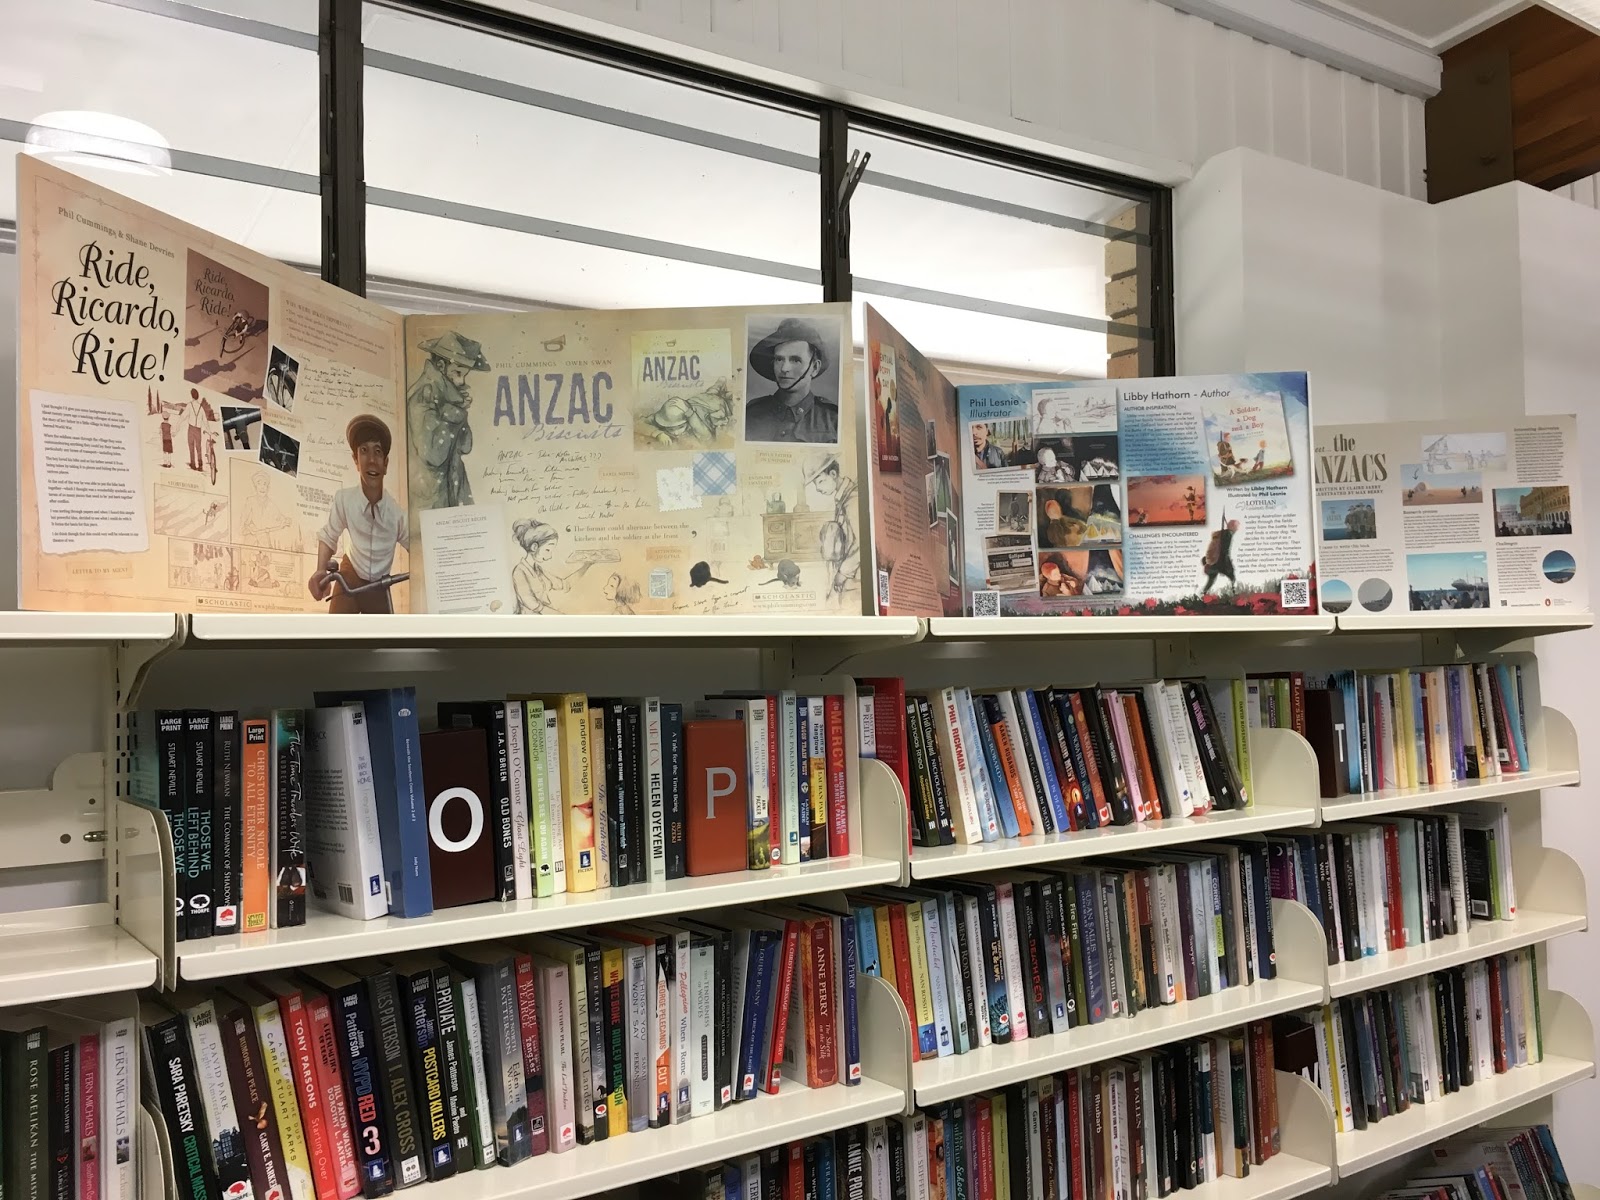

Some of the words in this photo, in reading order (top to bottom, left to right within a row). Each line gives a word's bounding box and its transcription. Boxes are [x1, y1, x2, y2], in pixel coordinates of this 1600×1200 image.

[58, 207, 74, 220] Phil
[76, 214, 117, 238] Cummings
[125, 233, 147, 248] Shane
[149, 242, 174, 259] Devries
[79, 241, 155, 295] Ride,
[203, 268, 227, 286] Ride,
[52, 277, 179, 338] Ricardo,
[195, 280, 235, 302] Ricardo,
[200, 297, 232, 318] Ride!
[72, 327, 169, 384] Ride!
[643, 355, 700, 382] ANZAC
[493, 371, 613, 426] ANZAC
[970, 399, 987, 407] Phil
[990, 398, 1019, 406] Lesnie
[1123, 392, 1148, 402] Libby
[1151, 392, 1190, 400] Hathorn
[1201, 389, 1231, 398] Author
[970, 409, 1011, 418] Illustrator
[523, 423, 626, 442] Biscuits
[1333, 434, 1355, 451] the
[204, 598, 250, 608] SCHOLASTIC
[509, 724, 518, 755] Joseph
[579, 719, 588, 755] andrew
[832, 711, 843, 768] MERCY
[863, 714, 871, 747] REILLY
[947, 704, 955, 727] PHIL
[951, 728, 966, 771] RICKMAN
[1335, 723, 1344, 762] T
[168, 743, 176, 767] STUART
[195, 741, 203, 765] STUART
[247, 764, 255, 777] TO
[499, 749, 507, 782] O'BRIEN
[1005, 747, 1015, 778] ROBARDS
[169, 768, 177, 796] NEVILLE
[247, 781, 255, 801] ALL
[257, 750, 265, 825] CHRISTOPHER
[513, 757, 522, 806] O'Connor
[650, 773, 660, 804] HELEN
[705, 766, 737, 819] P
[931, 758, 942, 789] NICHOLAS
[937, 791, 945, 816] RHEA
[188, 807, 199, 831] LEFT
[428, 787, 484, 853] O
[500, 798, 509, 815] OLD
[173, 812, 184, 850] THOSE
[200, 810, 211, 848] THOSE
[224, 822, 232, 858] COMPANY
[247, 805, 255, 858] ETERNITY
[501, 817, 511, 848] BONES
[651, 809, 663, 859] OYEYEMI
[175, 851, 185, 873] WE
[188, 833, 199, 878] BEHIND
[201, 848, 211, 870] WE
[1212, 877, 1220, 911] CORNER
[959, 922, 967, 945] BENT
[817, 946, 826, 979] ANNE
[961, 948, 970, 979] ROAD
[375, 975, 393, 1010] JAMES
[525, 980, 537, 1029] MICHAEL
[577, 990, 586, 1016] TIM
[818, 981, 829, 1017] PERRY
[921, 987, 929, 1022] ROSSITER
[936, 988, 944, 1023] ROSSITER
[437, 987, 456, 1035] PRIVATE
[345, 1012, 361, 1058] Patterson
[357, 1030, 365, 1049] James
[380, 1010, 400, 1062] PATTERSON
[579, 1021, 590, 1064] PEARS
[611, 1028, 622, 1060] RIDLEY
[30, 1060, 38, 1089] ROSE
[115, 1046, 125, 1077] FERN
[168, 1057, 182, 1082] SARA
[209, 1042, 222, 1079] DAVID
[217, 1084, 229, 1111] PARK
[352, 1057, 372, 1096] NYPD
[423, 1047, 440, 1098] POSTCARD
[658, 1067, 667, 1086] CUT
[85, 1073, 94, 1093] FERN
[267, 1032, 280, 1074] CARRIE
[275, 1078, 290, 1121] STUART
[285, 1126, 297, 1161] PARKS
[294, 1019, 307, 1051] TONY
[301, 1055, 316, 1109] PARSONS
[311, 1117, 321, 1156] Starting
[318, 1155, 328, 1180] Over
[582, 1069, 590, 1112] Landed
[613, 1061, 624, 1106] PEARSON
[30, 1095, 39, 1148] MELIKAN
[85, 1095, 95, 1136] MICHAELS
[115, 1079, 125, 1136] MICHAELS
[173, 1082, 194, 1133] PARETSKY
[357, 1094, 376, 1123] RED
[429, 1098, 446, 1141] KILLERS
[1094, 1094, 1102, 1134] Rhubarb
[362, 1125, 380, 1156] 3
[396, 1112, 415, 1155] CROSS
[183, 1135, 198, 1177] CRITICAL
[848, 1143, 862, 1175] ANNIE
